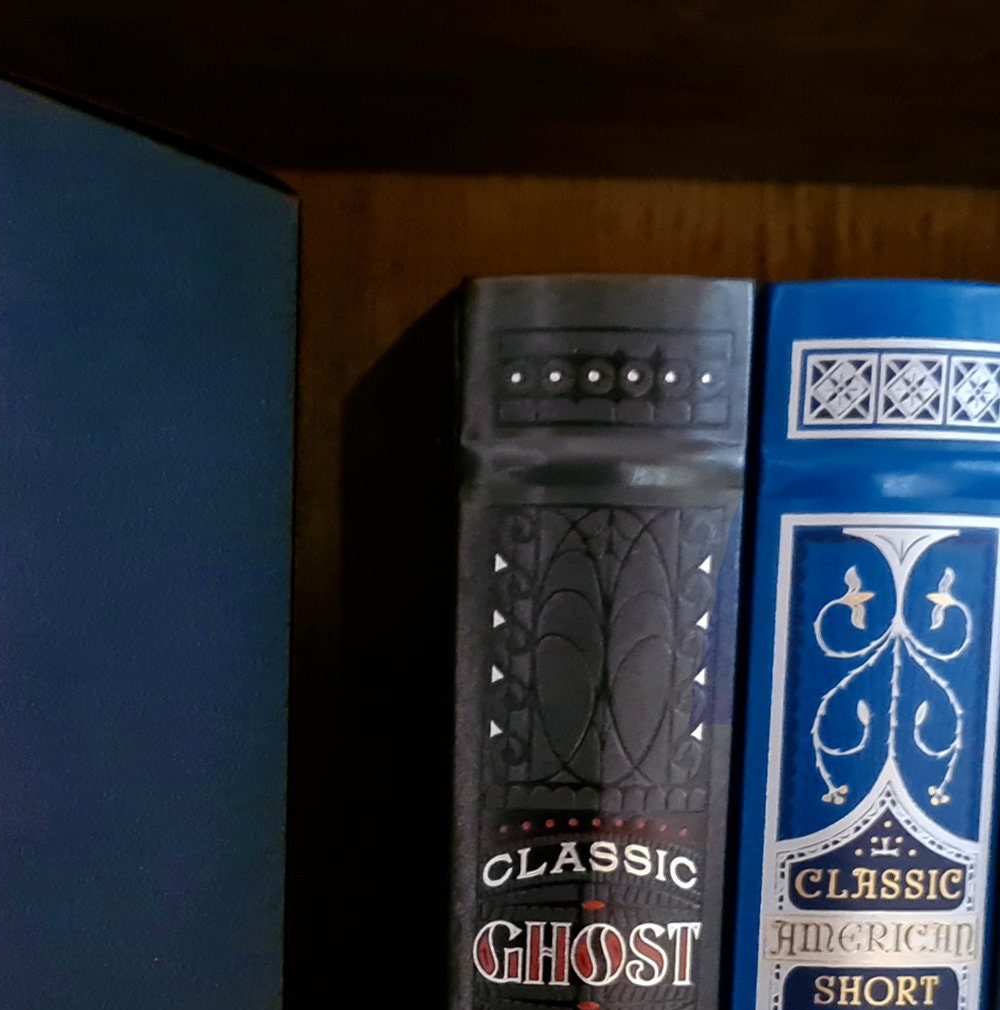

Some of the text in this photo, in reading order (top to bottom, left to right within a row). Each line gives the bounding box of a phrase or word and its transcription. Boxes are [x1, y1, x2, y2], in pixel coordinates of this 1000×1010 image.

[482, 841, 698, 890] CLASSIC
[794, 867, 963, 900] CLASSIC
[473, 919, 702, 987] GHOST
[769, 919, 976, 957] AMERICAN
[814, 975, 940, 1007] SHORT
